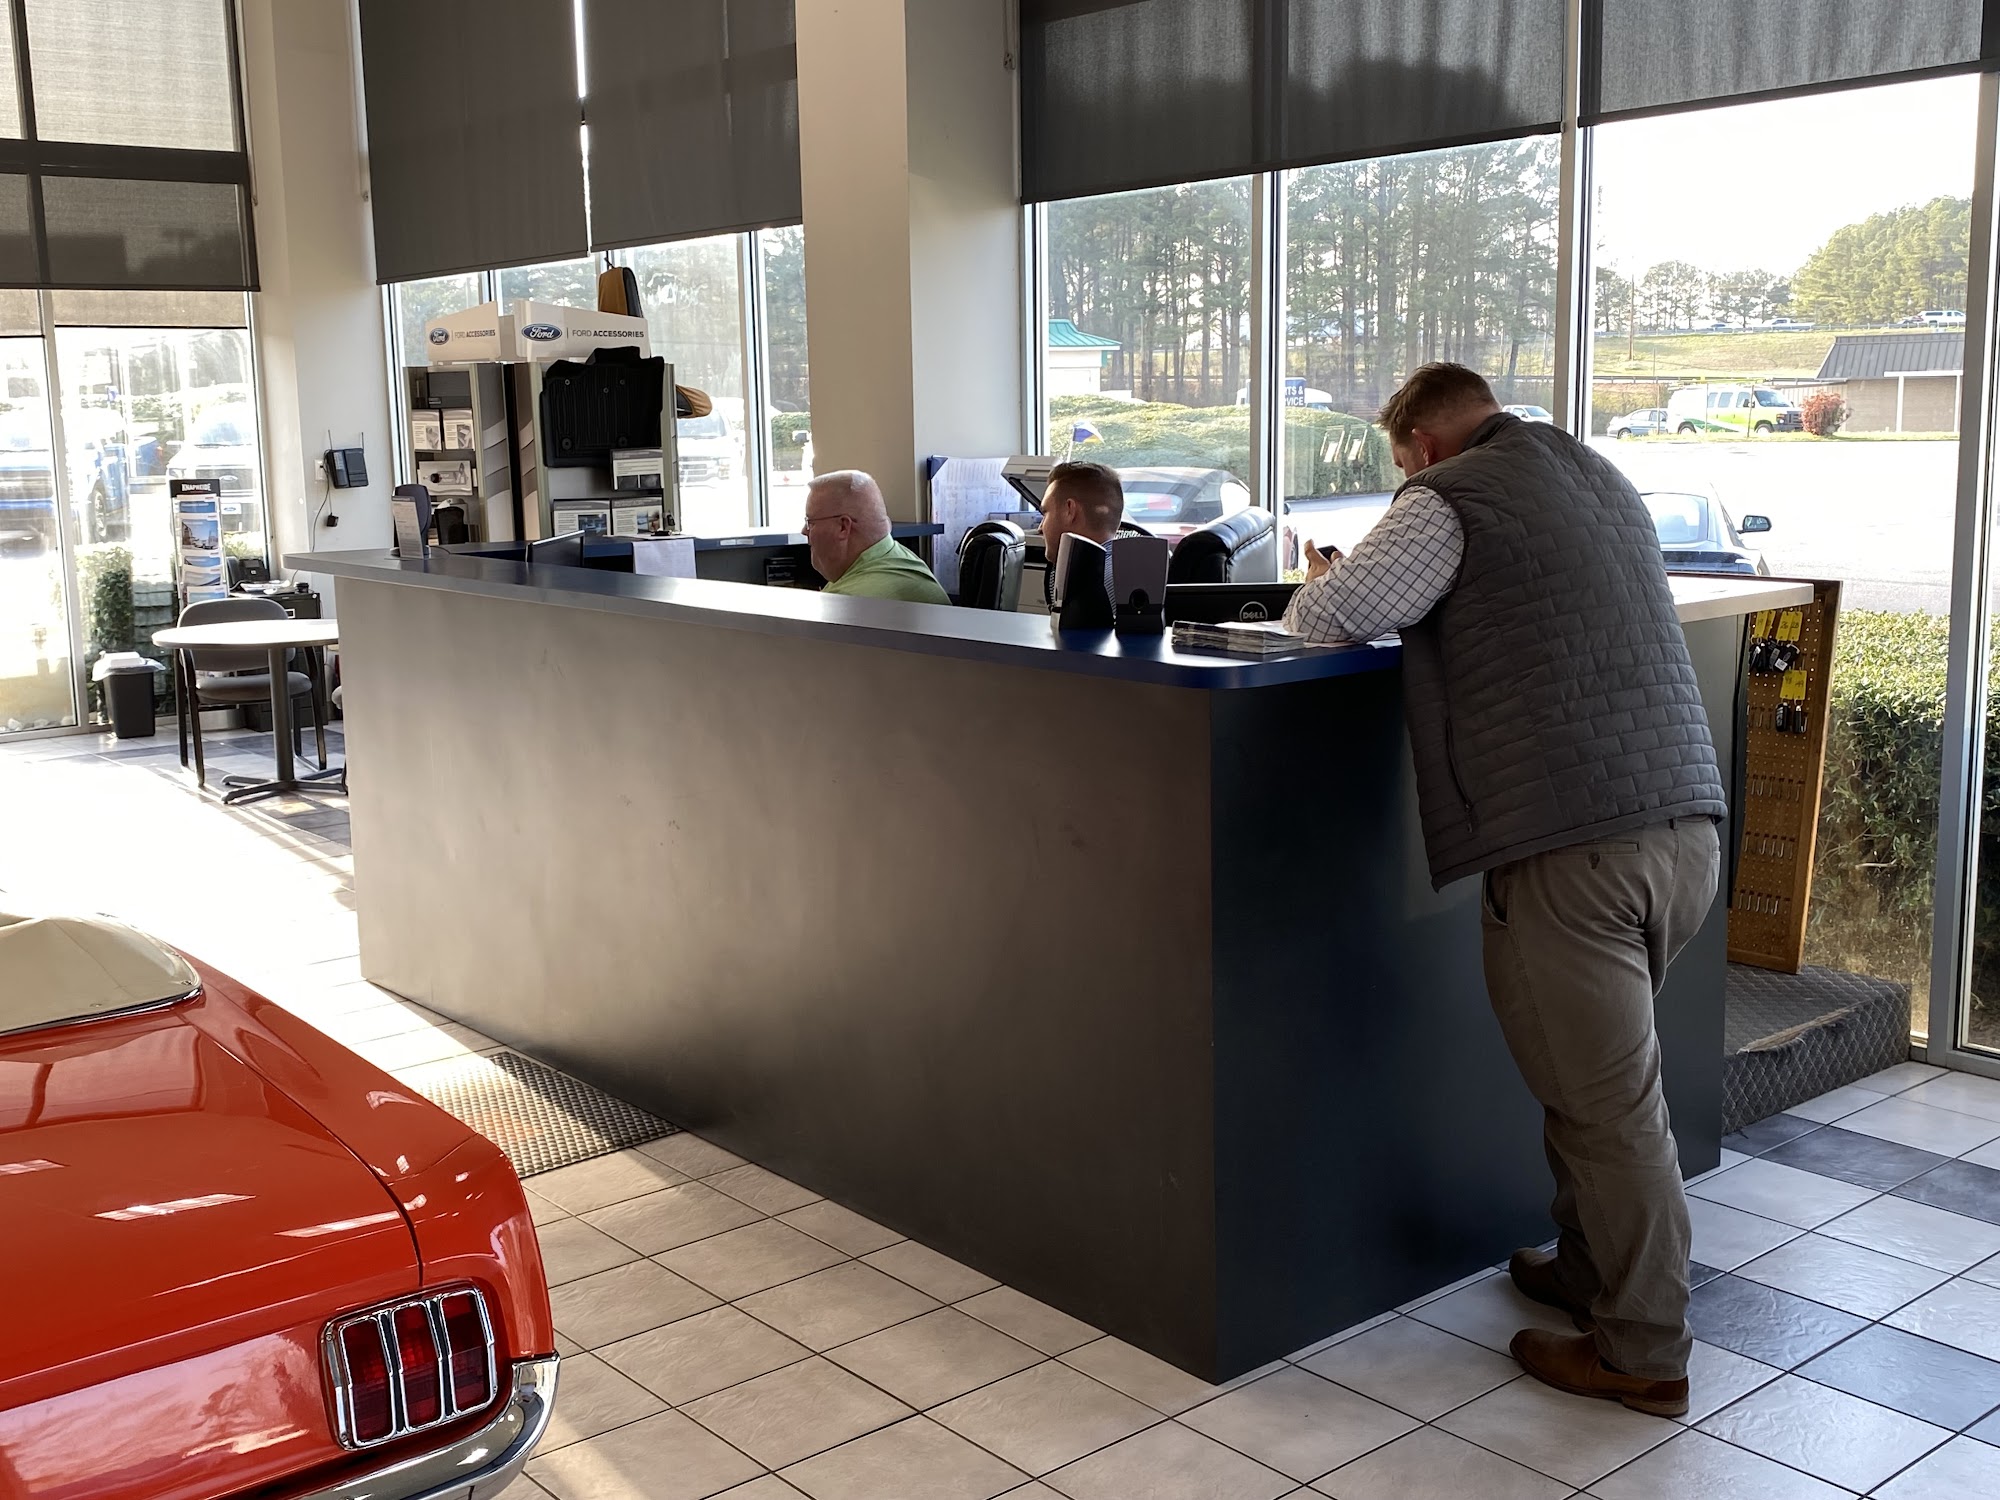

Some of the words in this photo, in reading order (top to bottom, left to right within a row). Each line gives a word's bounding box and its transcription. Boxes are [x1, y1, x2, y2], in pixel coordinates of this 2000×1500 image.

[466, 329, 496, 338] ACCESSORIES
[529, 326, 555, 339] Ford
[572, 329, 592, 337] FORD
[593, 330, 645, 338] ACCESSORIES
[1242, 611, 1265, 619] DELL
